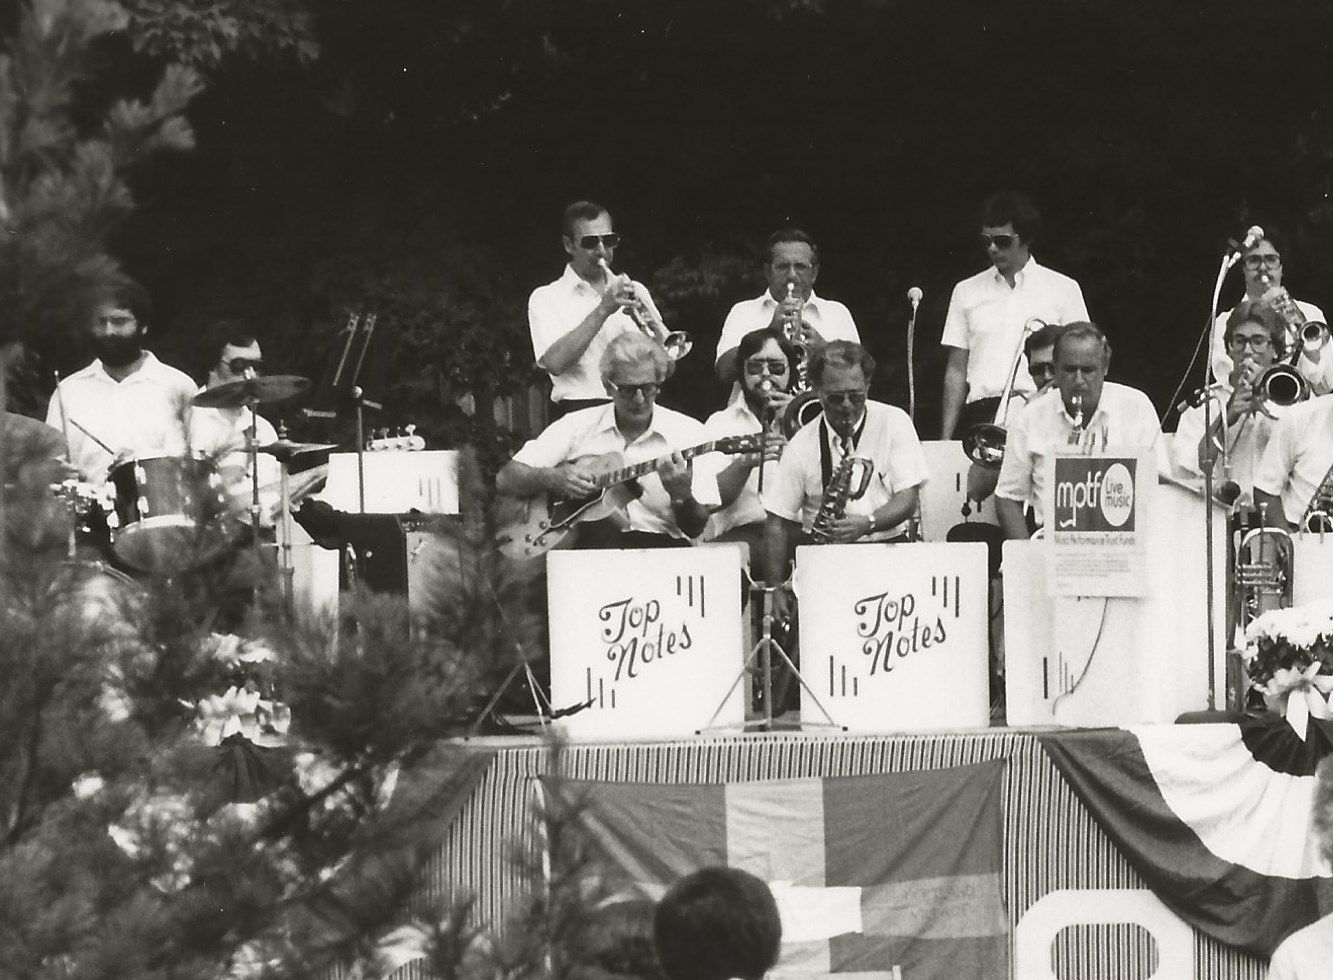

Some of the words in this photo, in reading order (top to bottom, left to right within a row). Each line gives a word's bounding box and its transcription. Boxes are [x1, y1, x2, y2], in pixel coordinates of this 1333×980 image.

[1056, 470, 1102, 528] mptf
[1105, 477, 1124, 495] Live
[599, 597, 660, 644] Top
[854, 591, 915, 639] Top
[607, 620, 692, 682] Notes
[862, 614, 947, 676] Notes
